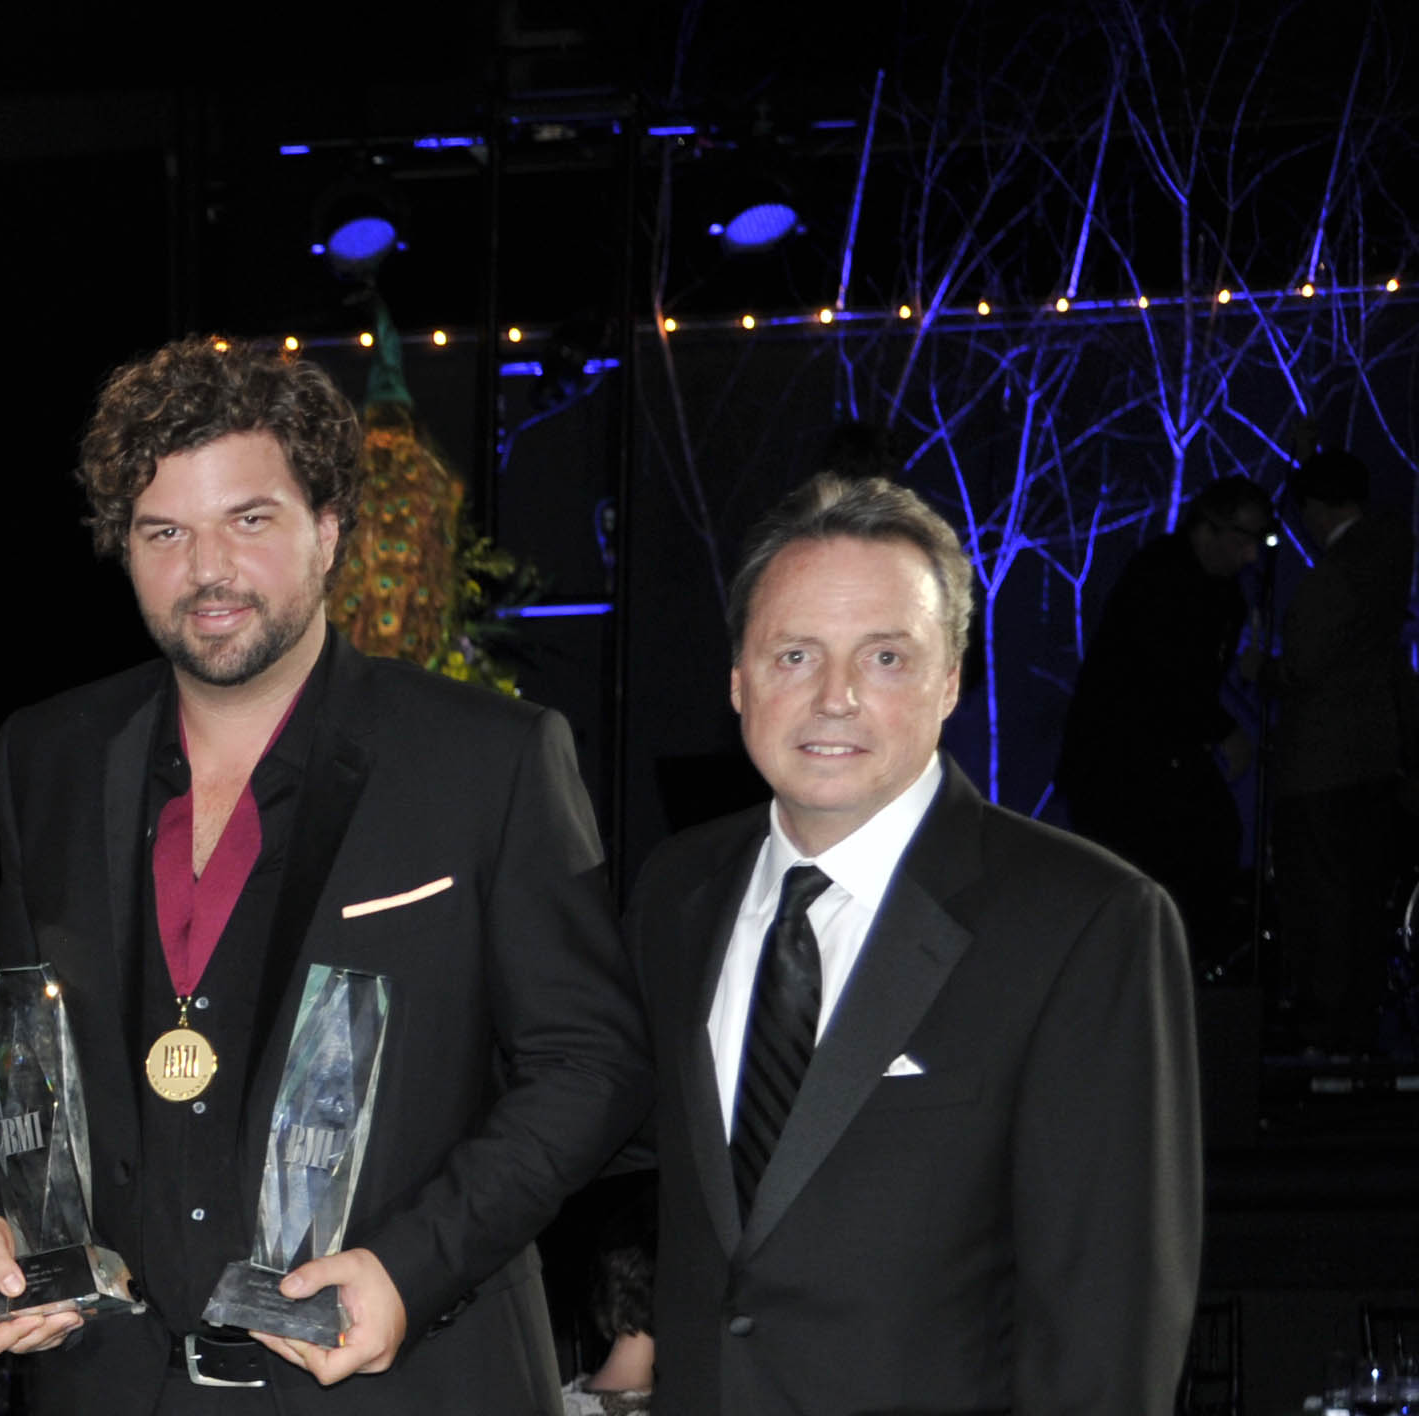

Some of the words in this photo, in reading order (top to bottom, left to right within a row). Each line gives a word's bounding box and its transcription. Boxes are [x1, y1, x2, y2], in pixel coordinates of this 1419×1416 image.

[164, 1045, 199, 1078] BMI
[0, 1111, 44, 1156] BMI
[283, 1124, 335, 1169] BMI
